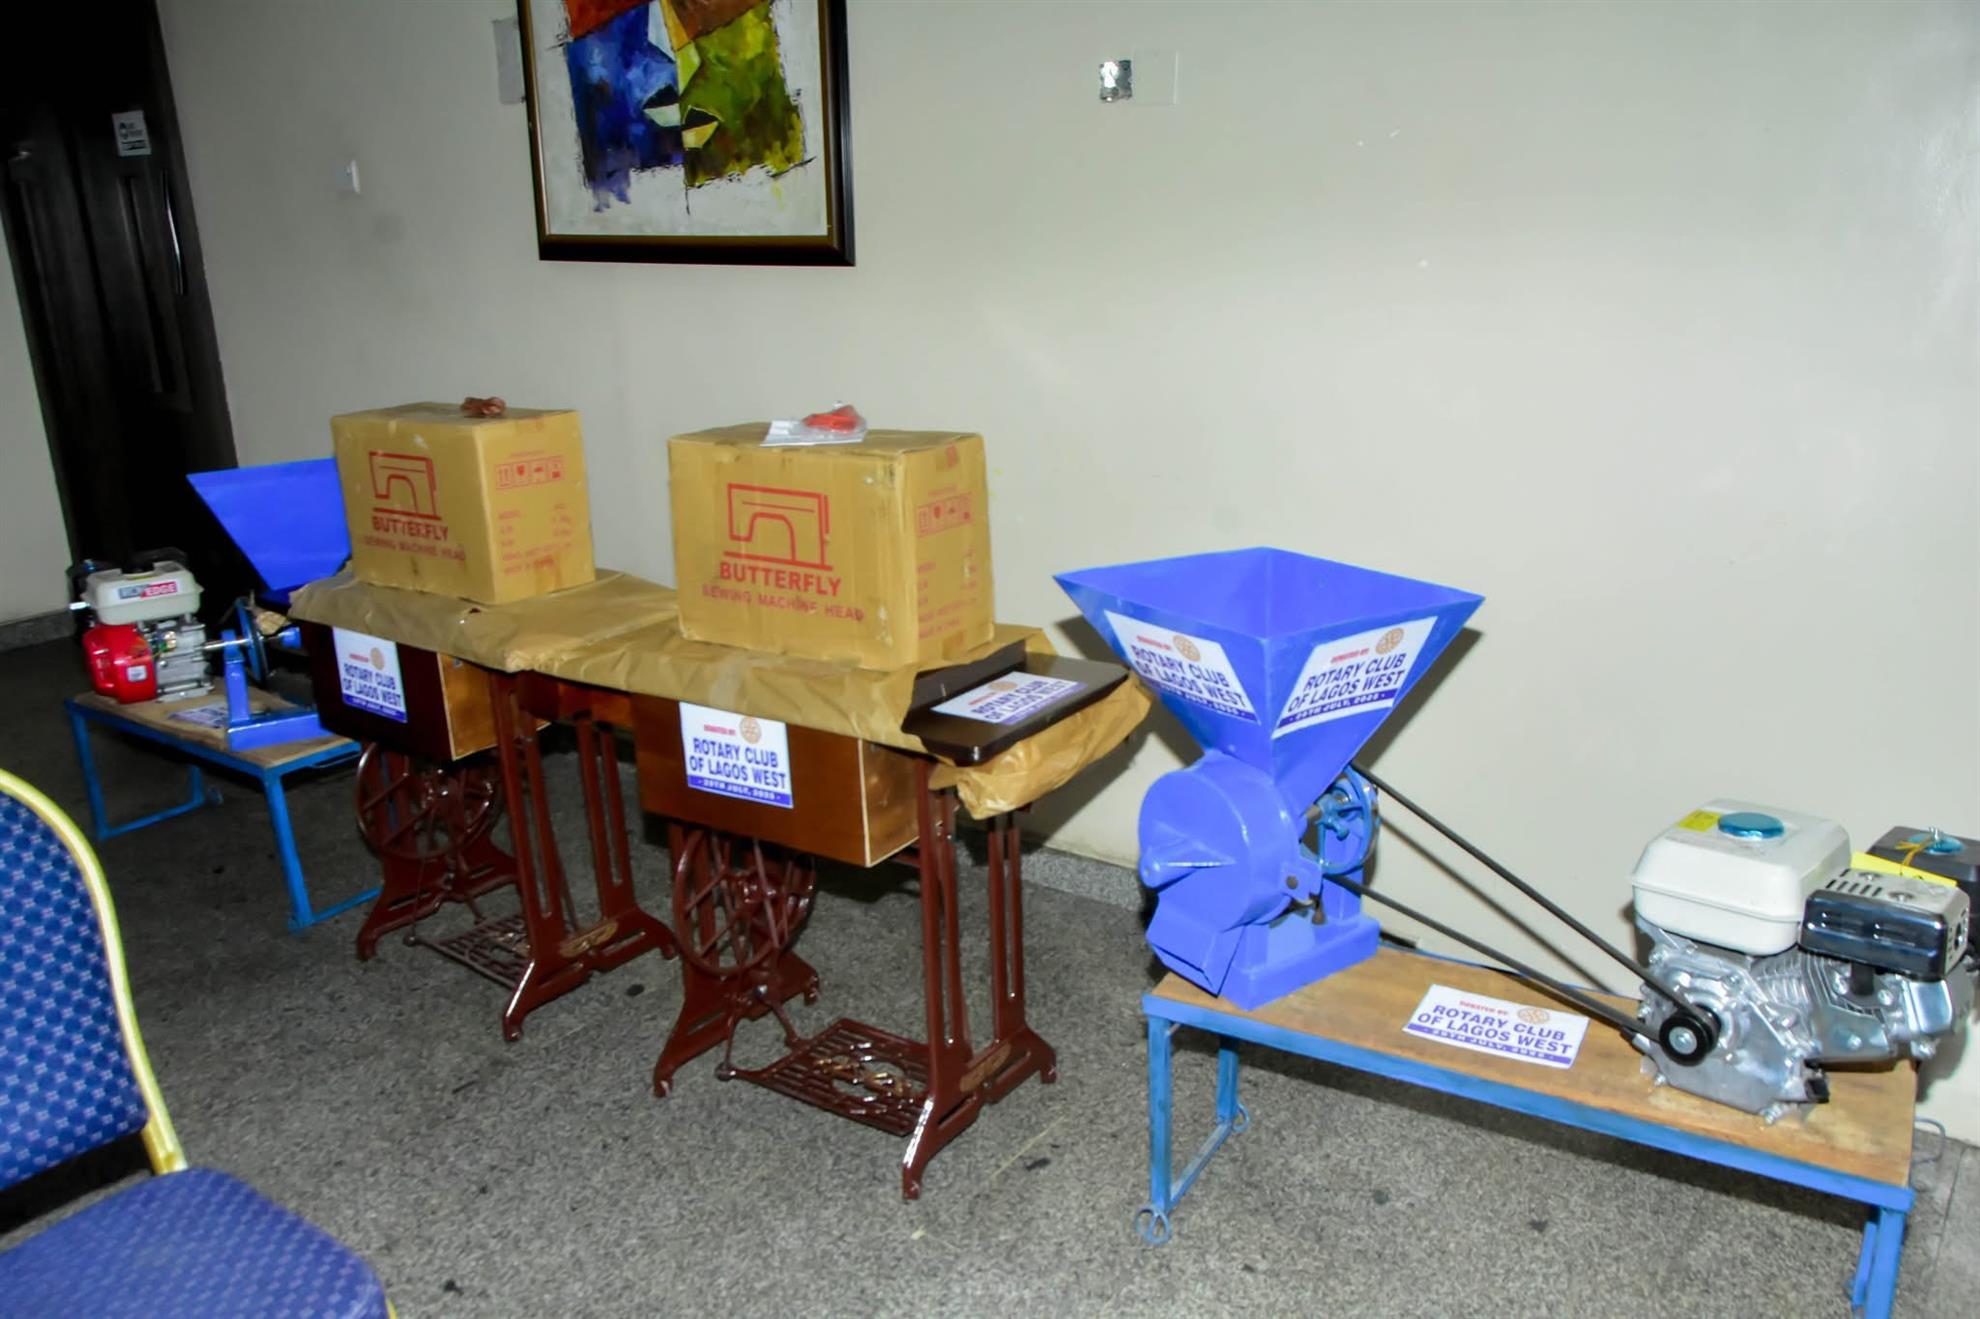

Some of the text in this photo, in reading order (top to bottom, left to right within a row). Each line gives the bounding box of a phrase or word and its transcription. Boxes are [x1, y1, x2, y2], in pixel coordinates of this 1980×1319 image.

[720, 561, 841, 597] BUTTERFLY
[702, 583, 865, 622] SEWING MACHINE HEAD
[1131, 645, 1230, 687] ROTARY CLUB
[1304, 653, 1407, 691] ROTARY CLUB
[1155, 667, 1203, 694] LAGOS
[1203, 681, 1247, 707] WEST
[1288, 670, 1405, 713] OF LAGOS WEST
[693, 737, 778, 768] ROTARY CLUB
[689, 755, 786, 789] OF LAGOS WEST
[1417, 1012, 1573, 1054] OF LAGOS WEST
[1432, 1004, 1566, 1041] ROTARY CLUB
